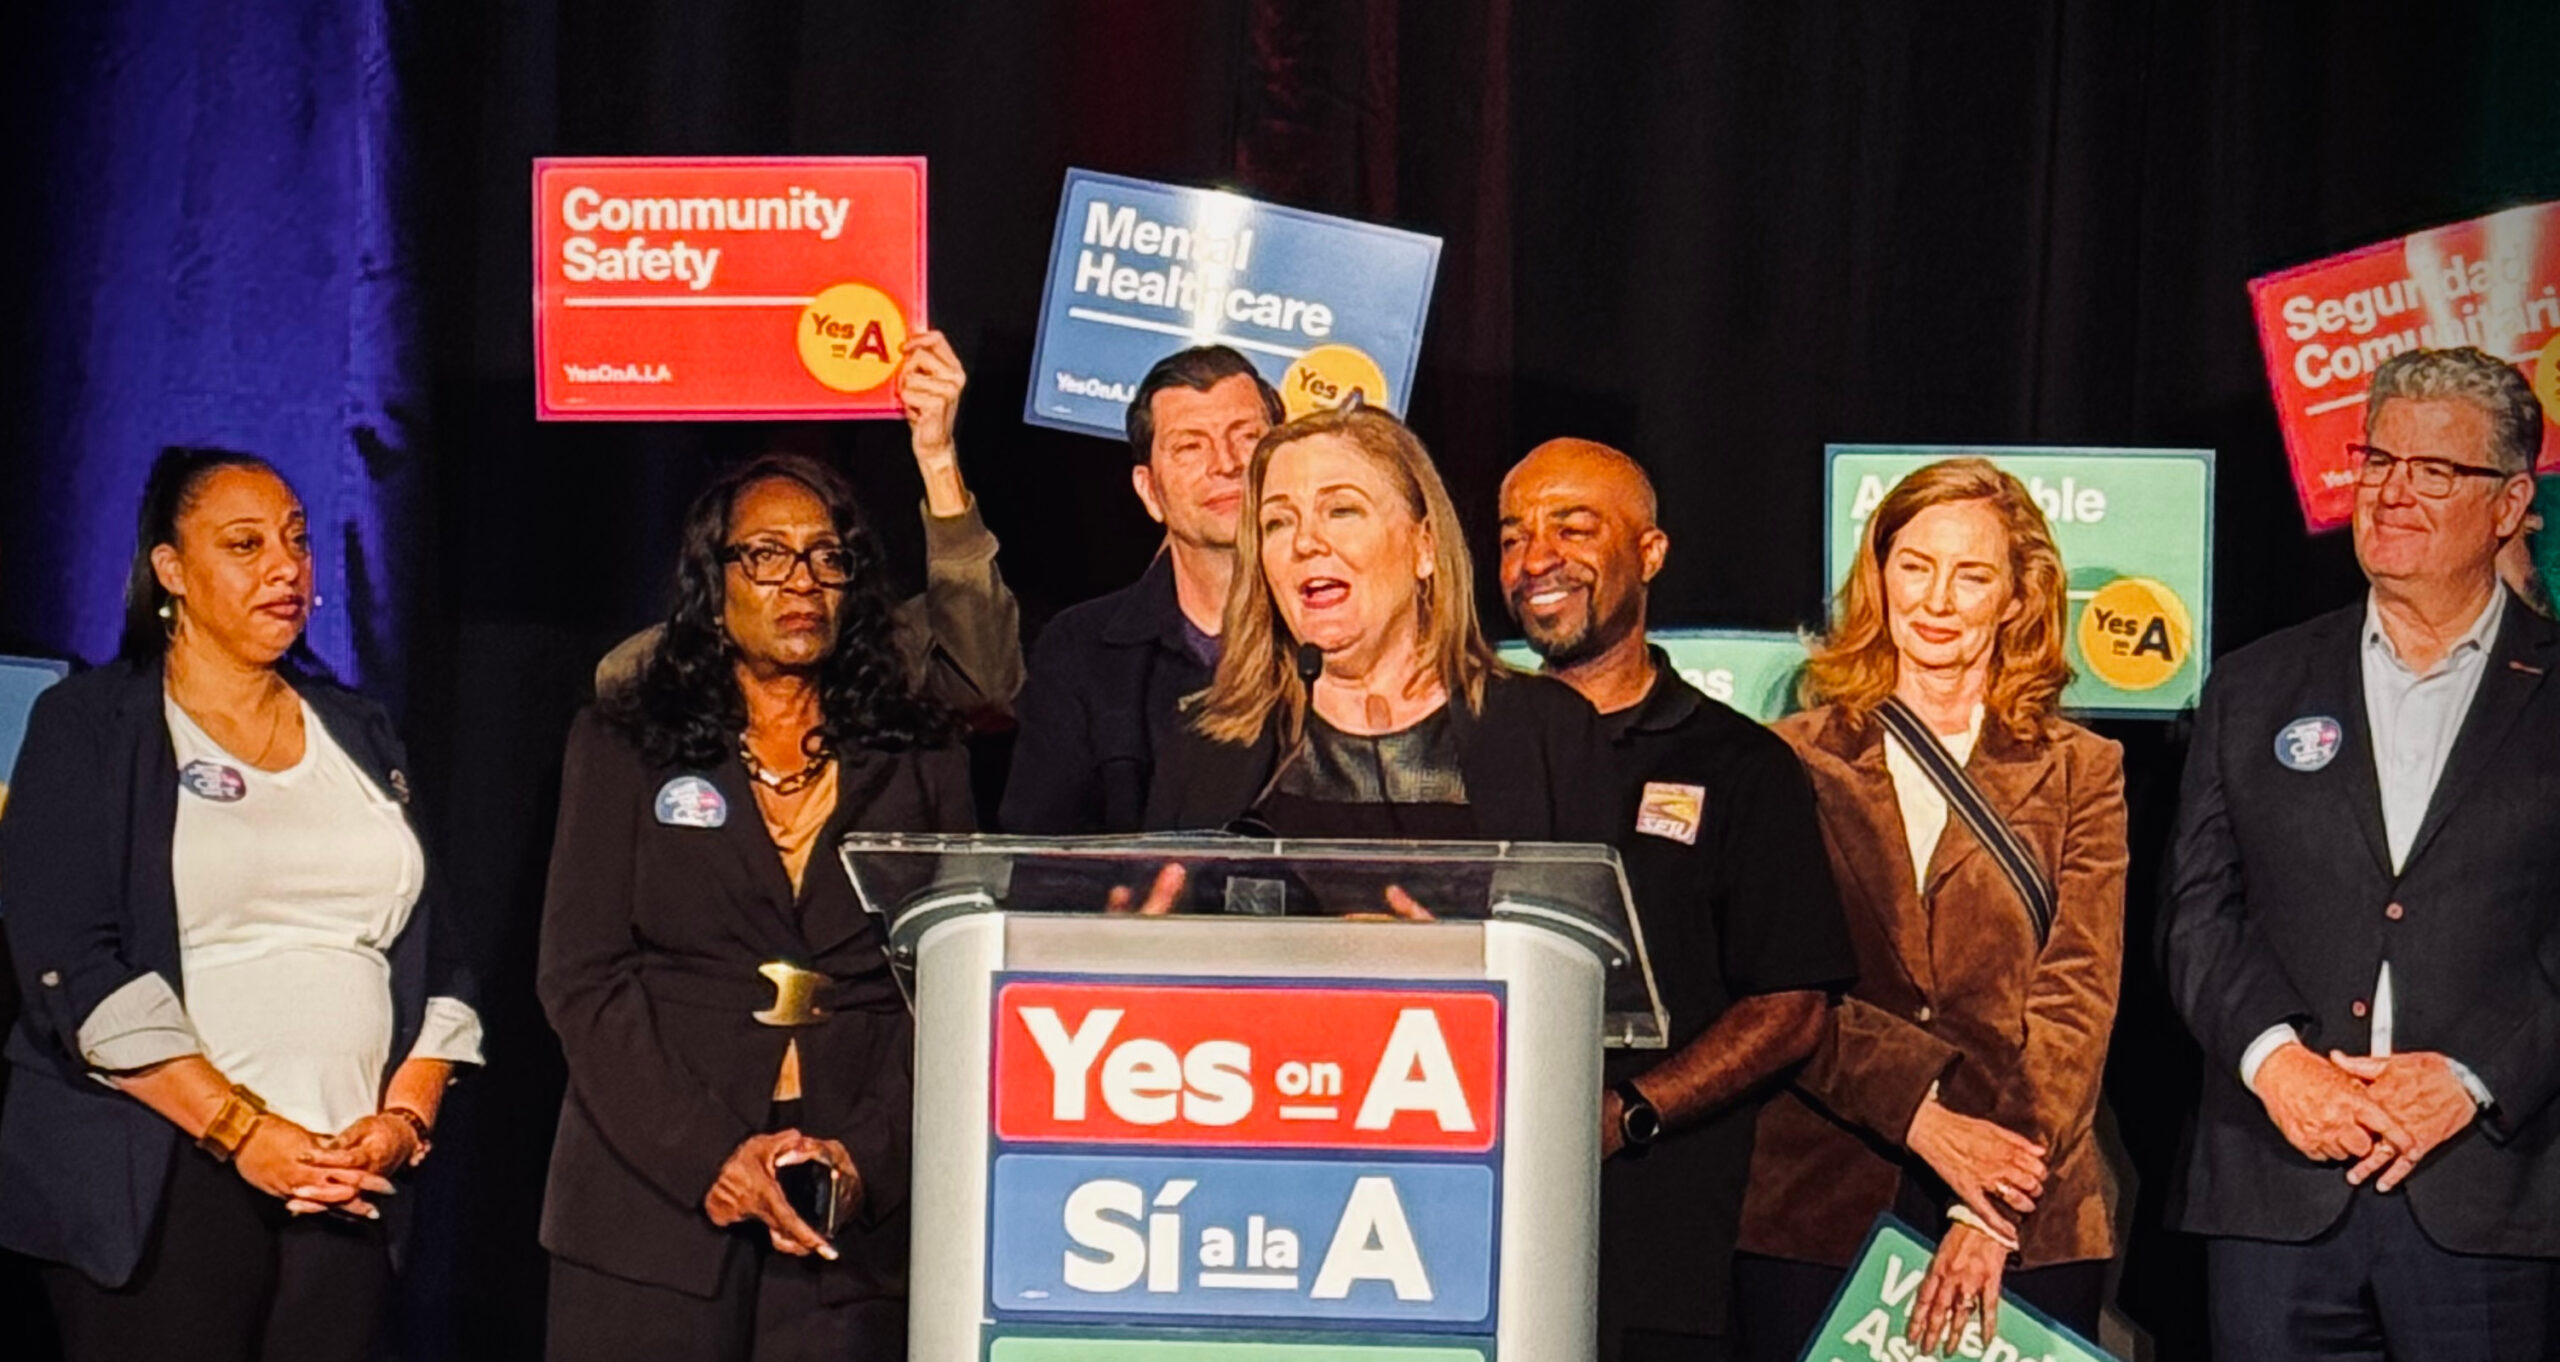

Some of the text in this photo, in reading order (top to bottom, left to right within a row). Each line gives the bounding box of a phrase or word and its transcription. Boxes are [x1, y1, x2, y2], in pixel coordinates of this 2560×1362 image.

[562, 187, 850, 239] Community
[562, 237, 720, 290] Safety
[2283, 243, 2529, 341] Segurdad
[811, 312, 890, 363] Yes A
[1300, 367, 1338, 400] Yes
[2094, 607, 2138, 637] Yes
[2131, 616, 2174, 662] A
[1018, 1006, 1477, 1132] Yes on A
[1063, 1176, 1434, 1301] Sí a la A
